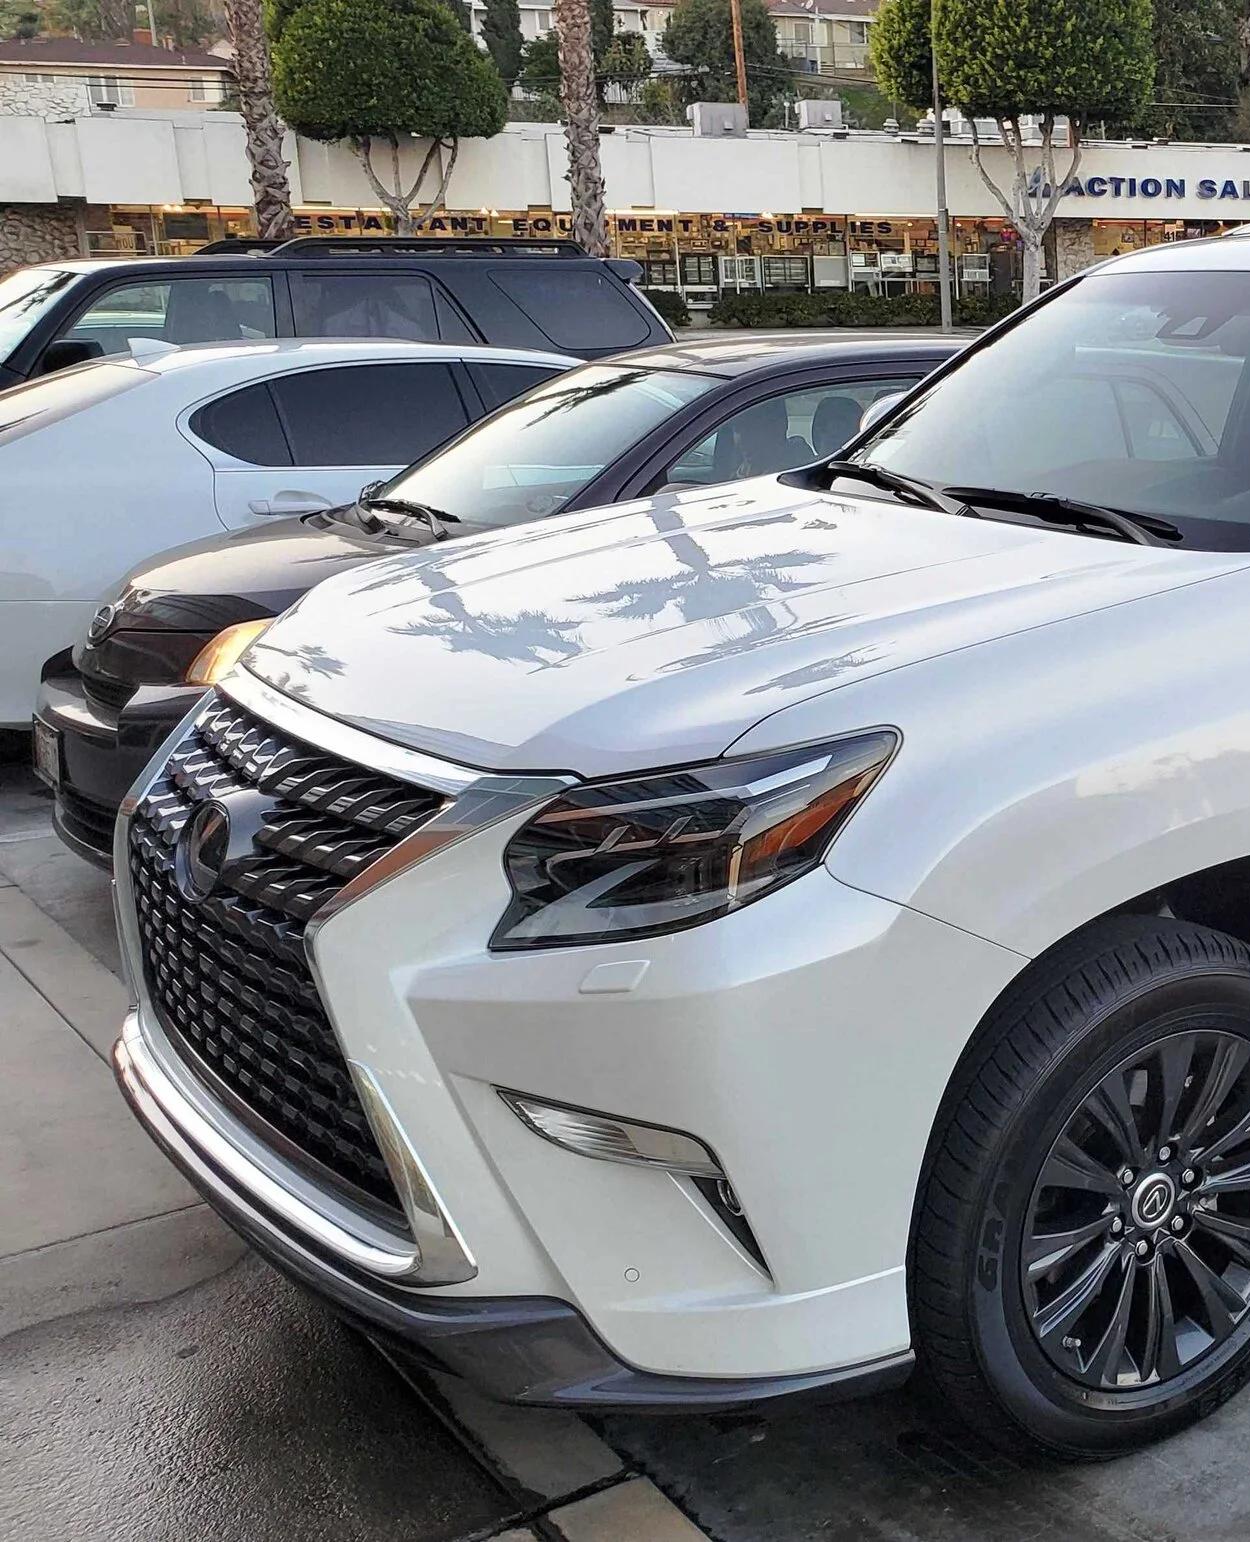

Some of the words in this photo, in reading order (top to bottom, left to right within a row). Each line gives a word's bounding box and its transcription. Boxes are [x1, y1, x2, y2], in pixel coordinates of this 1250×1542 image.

[1065, 176, 1186, 199] ACTION
[513, 218, 694, 232] EQUMENT
[713, 219, 729, 232] &
[758, 220, 893, 234] SUPPLIES
